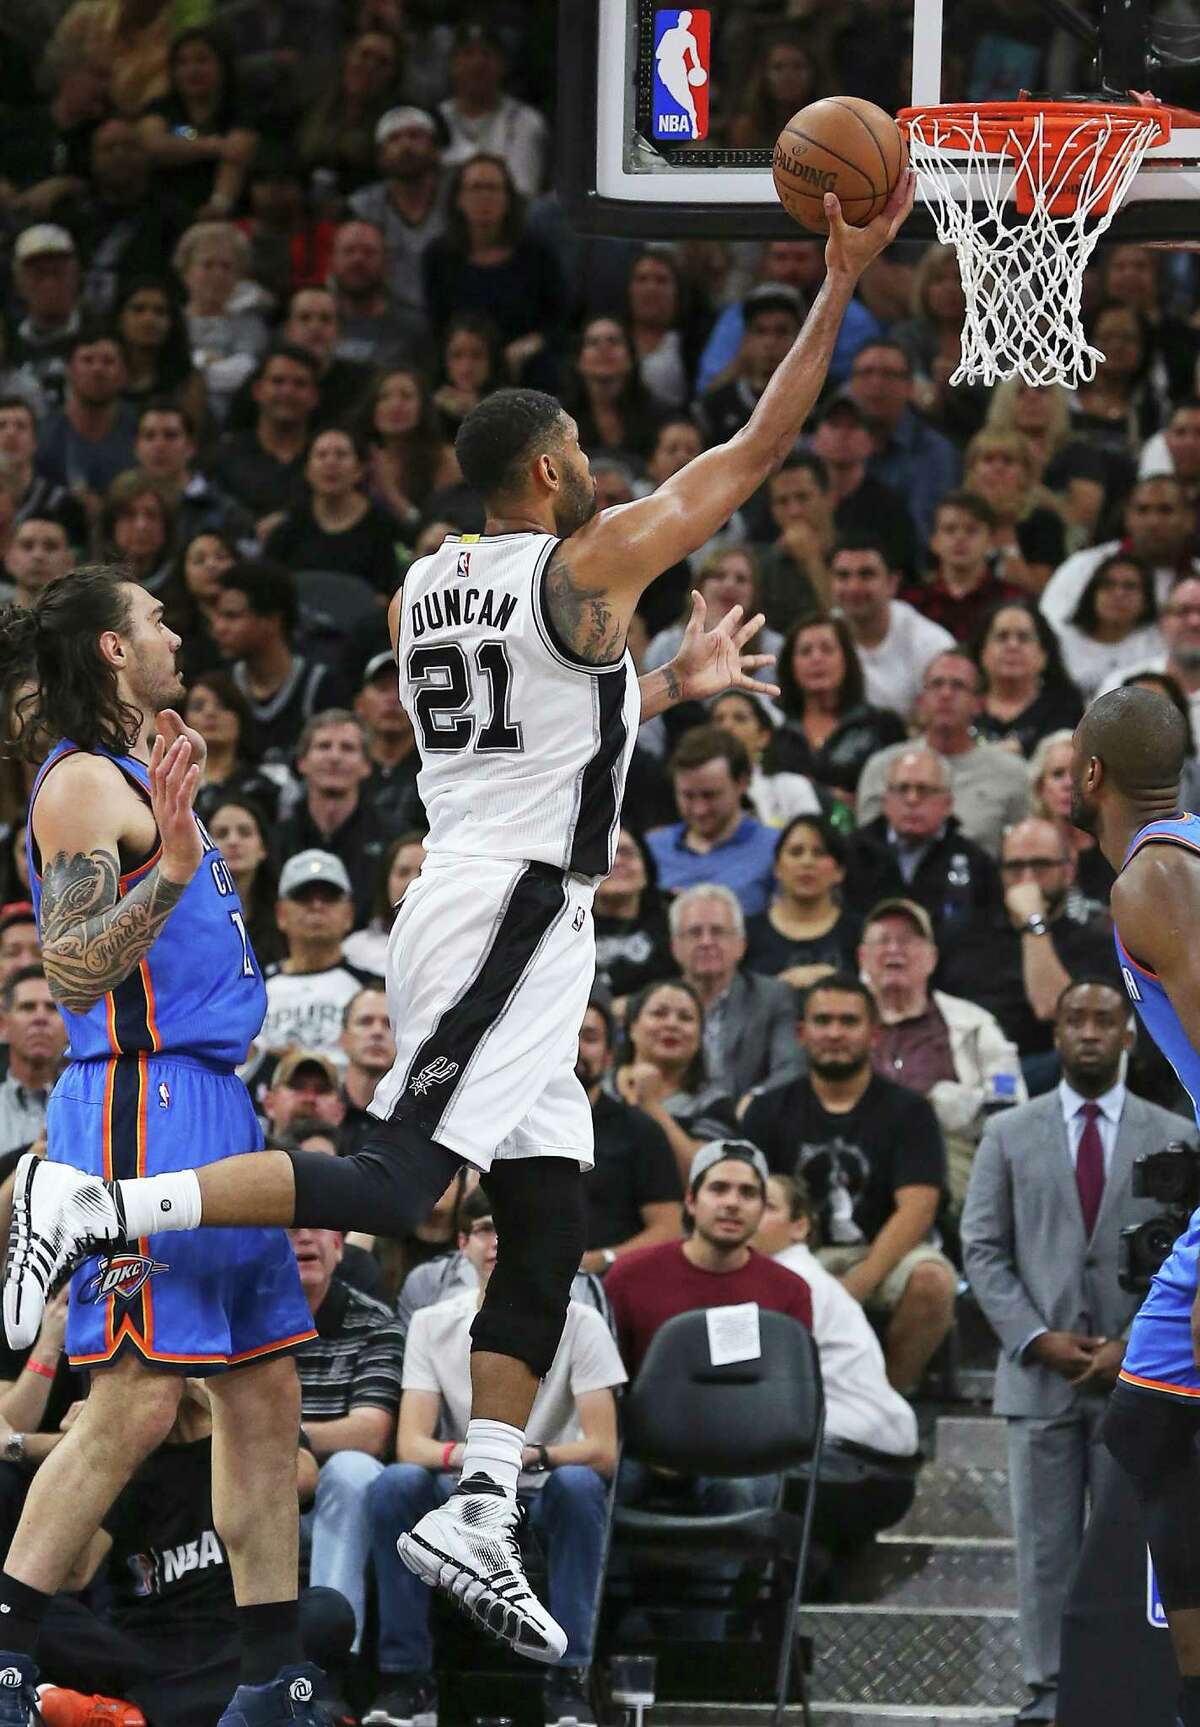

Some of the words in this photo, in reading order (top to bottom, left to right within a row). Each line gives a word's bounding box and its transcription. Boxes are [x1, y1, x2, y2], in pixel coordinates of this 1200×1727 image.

[658, 114, 690, 132] NBA
[773, 143, 839, 191] PALDING
[411, 588, 518, 638] DUNCAN
[407, 640, 524, 753] 21
[101, 1262, 141, 1293] OKC
